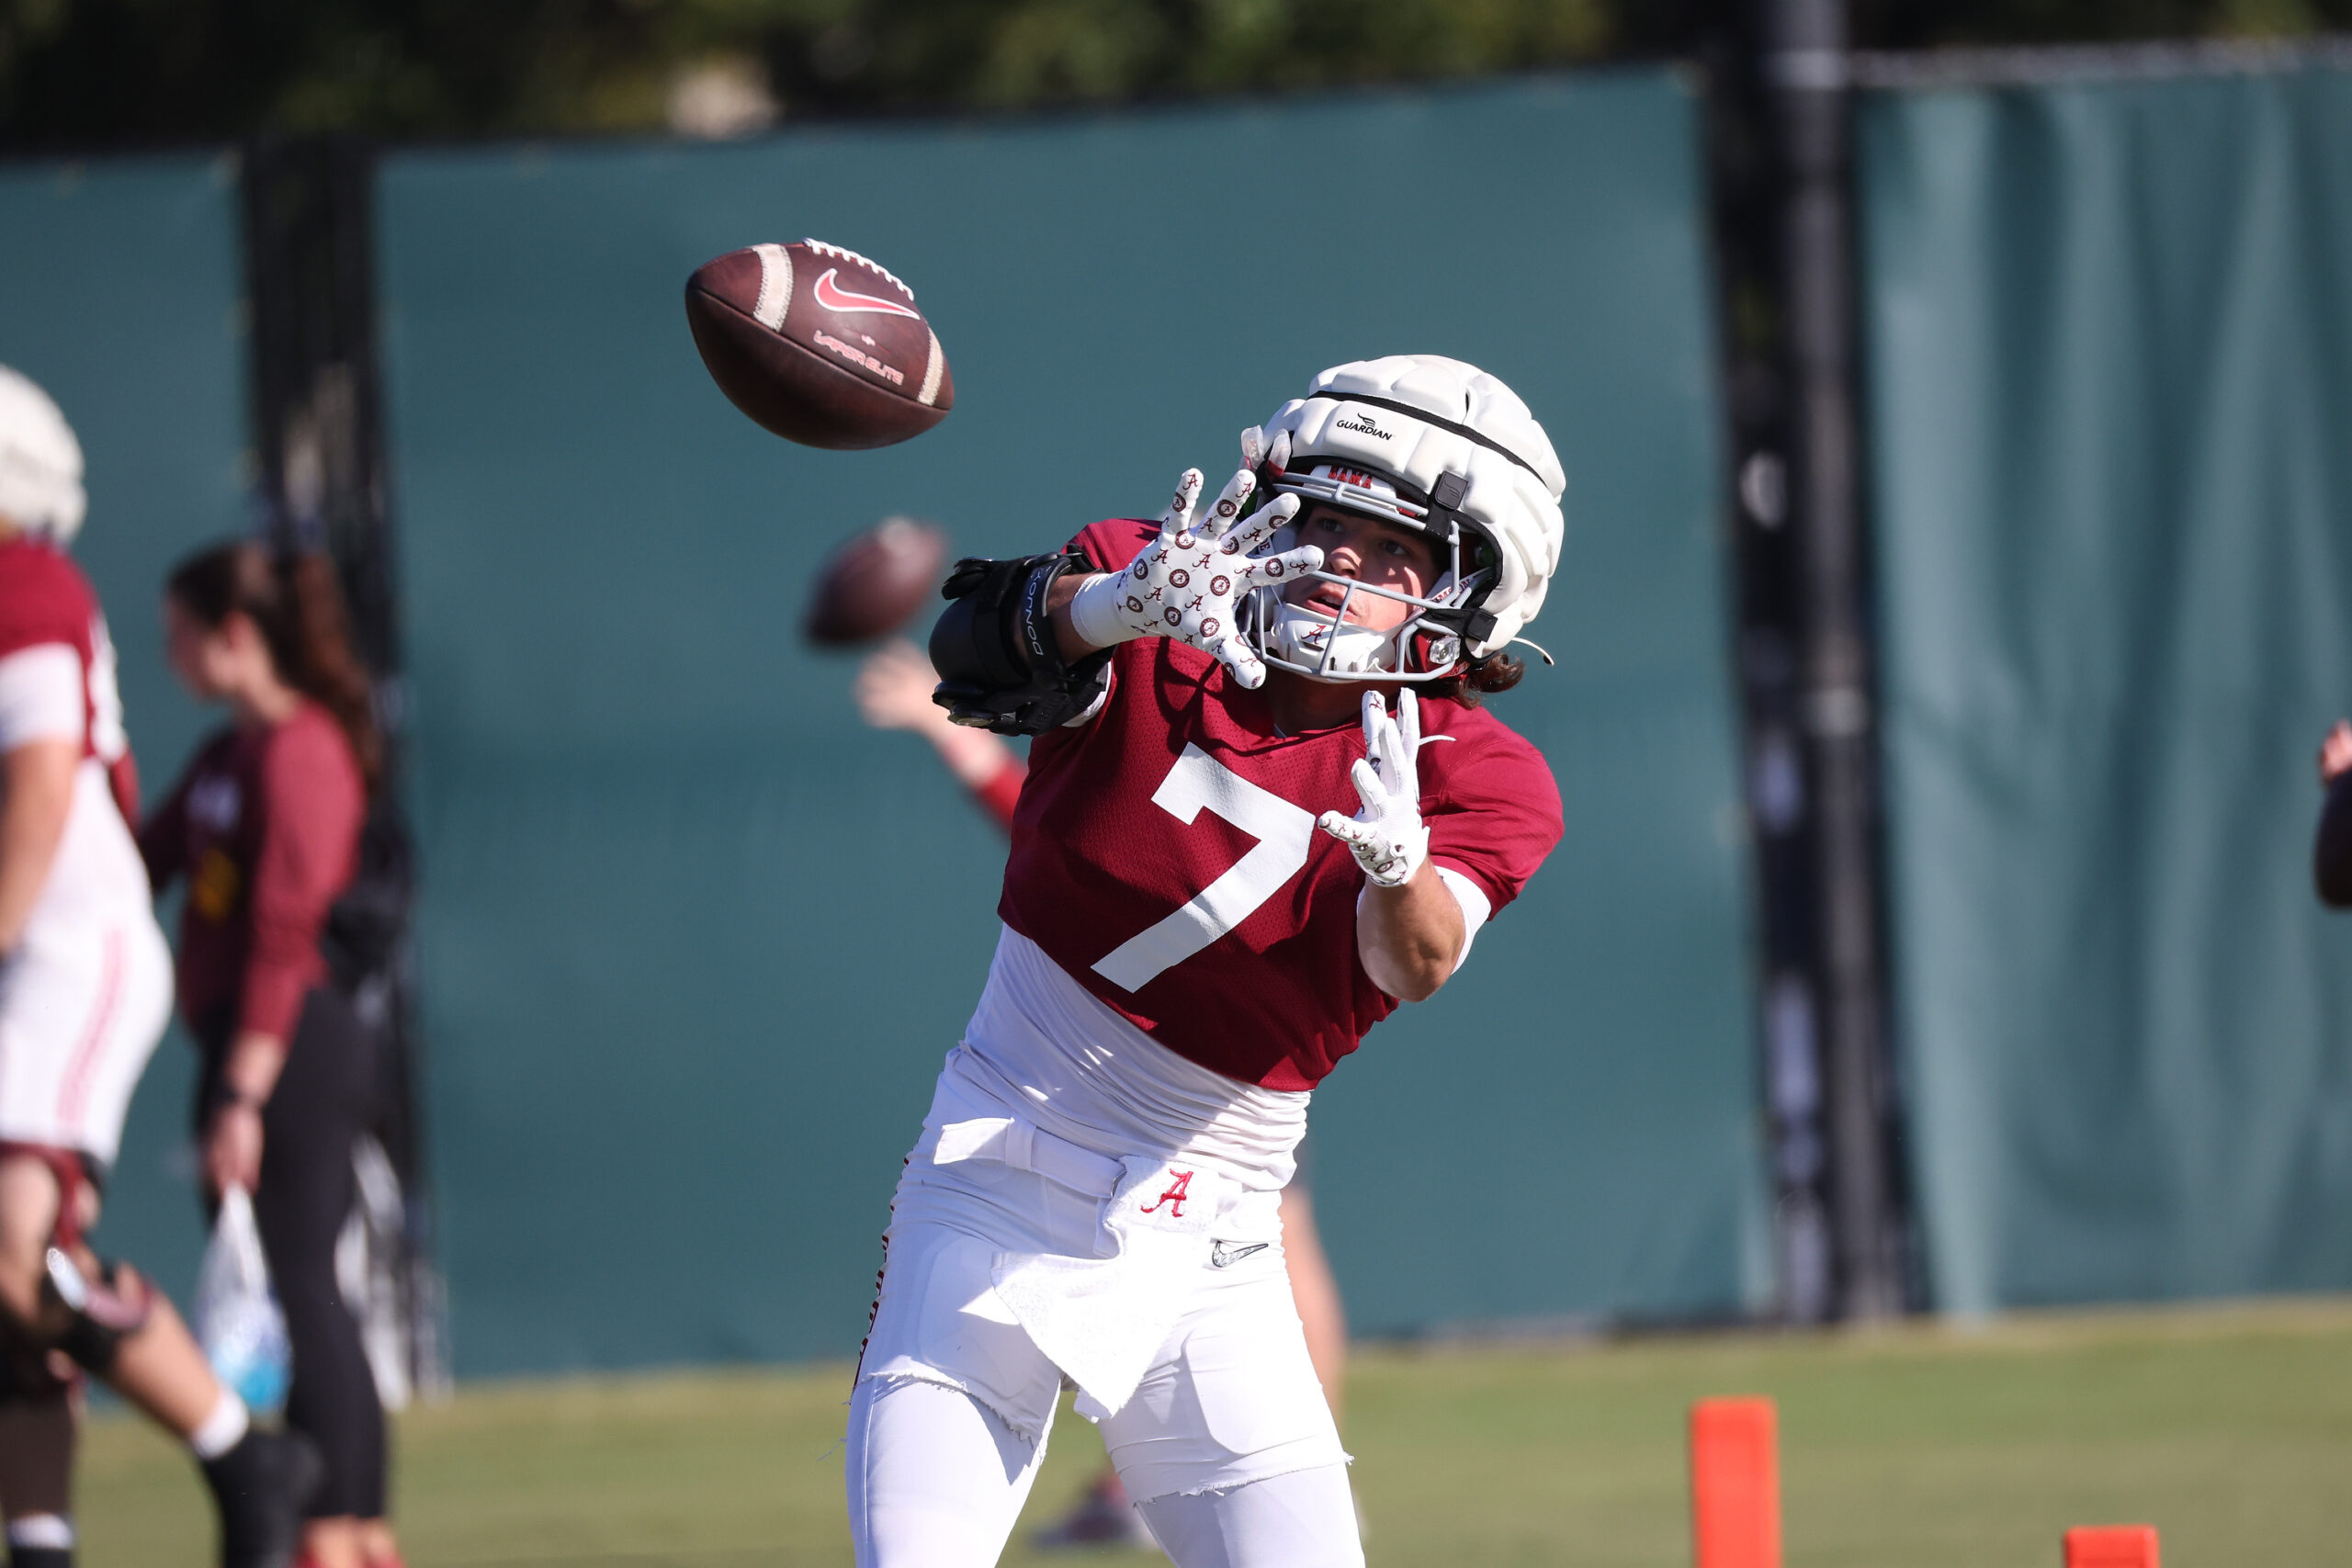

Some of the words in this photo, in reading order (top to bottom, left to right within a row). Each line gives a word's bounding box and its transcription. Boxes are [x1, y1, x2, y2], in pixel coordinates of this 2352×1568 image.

[1336, 420, 1393, 441] GUARDIAN
[1182, 473, 1198, 490] A
[1236, 481, 1251, 498] A
[1242, 526, 1261, 542] A
[1151, 548, 1169, 564] A
[1192, 553, 1211, 569] A
[1289, 559, 1309, 574] A
[1144, 586, 1162, 602] A
[1184, 594, 1203, 612] A
[1024, 570, 1044, 656] DONJOY
[1300, 623, 1327, 645] A
[1090, 741, 1317, 993] 7
[1140, 1168, 1193, 1218] A
